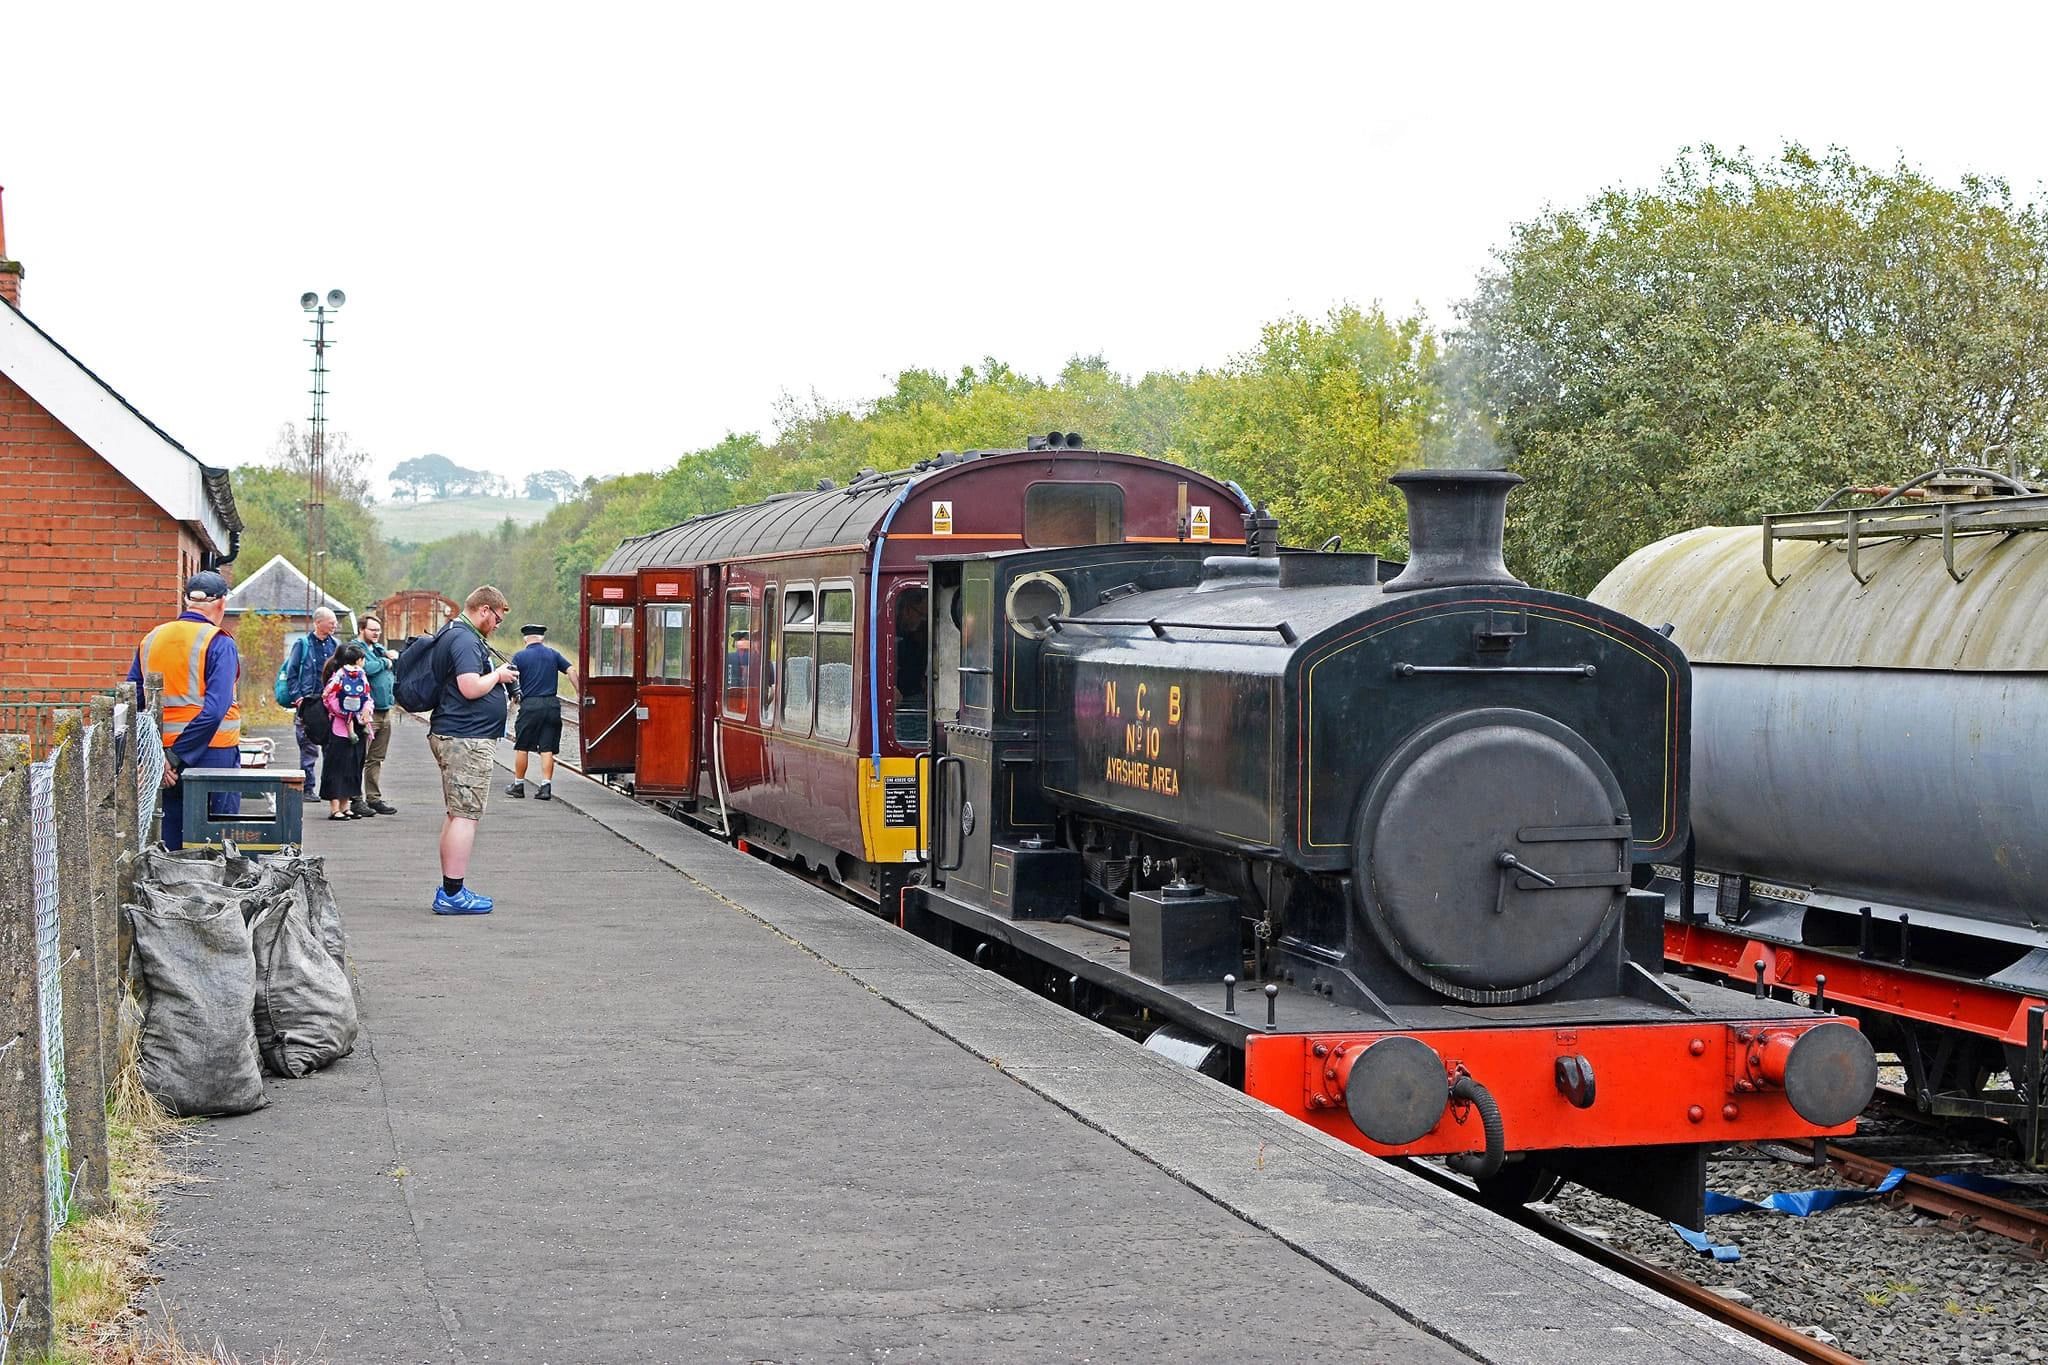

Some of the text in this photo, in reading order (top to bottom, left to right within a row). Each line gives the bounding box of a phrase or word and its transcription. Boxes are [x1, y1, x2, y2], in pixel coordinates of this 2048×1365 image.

[1146, 727, 1160, 760] 10
[1106, 756, 1179, 796] AYRSHIRE AREA
[221, 828, 260, 841] Litter
